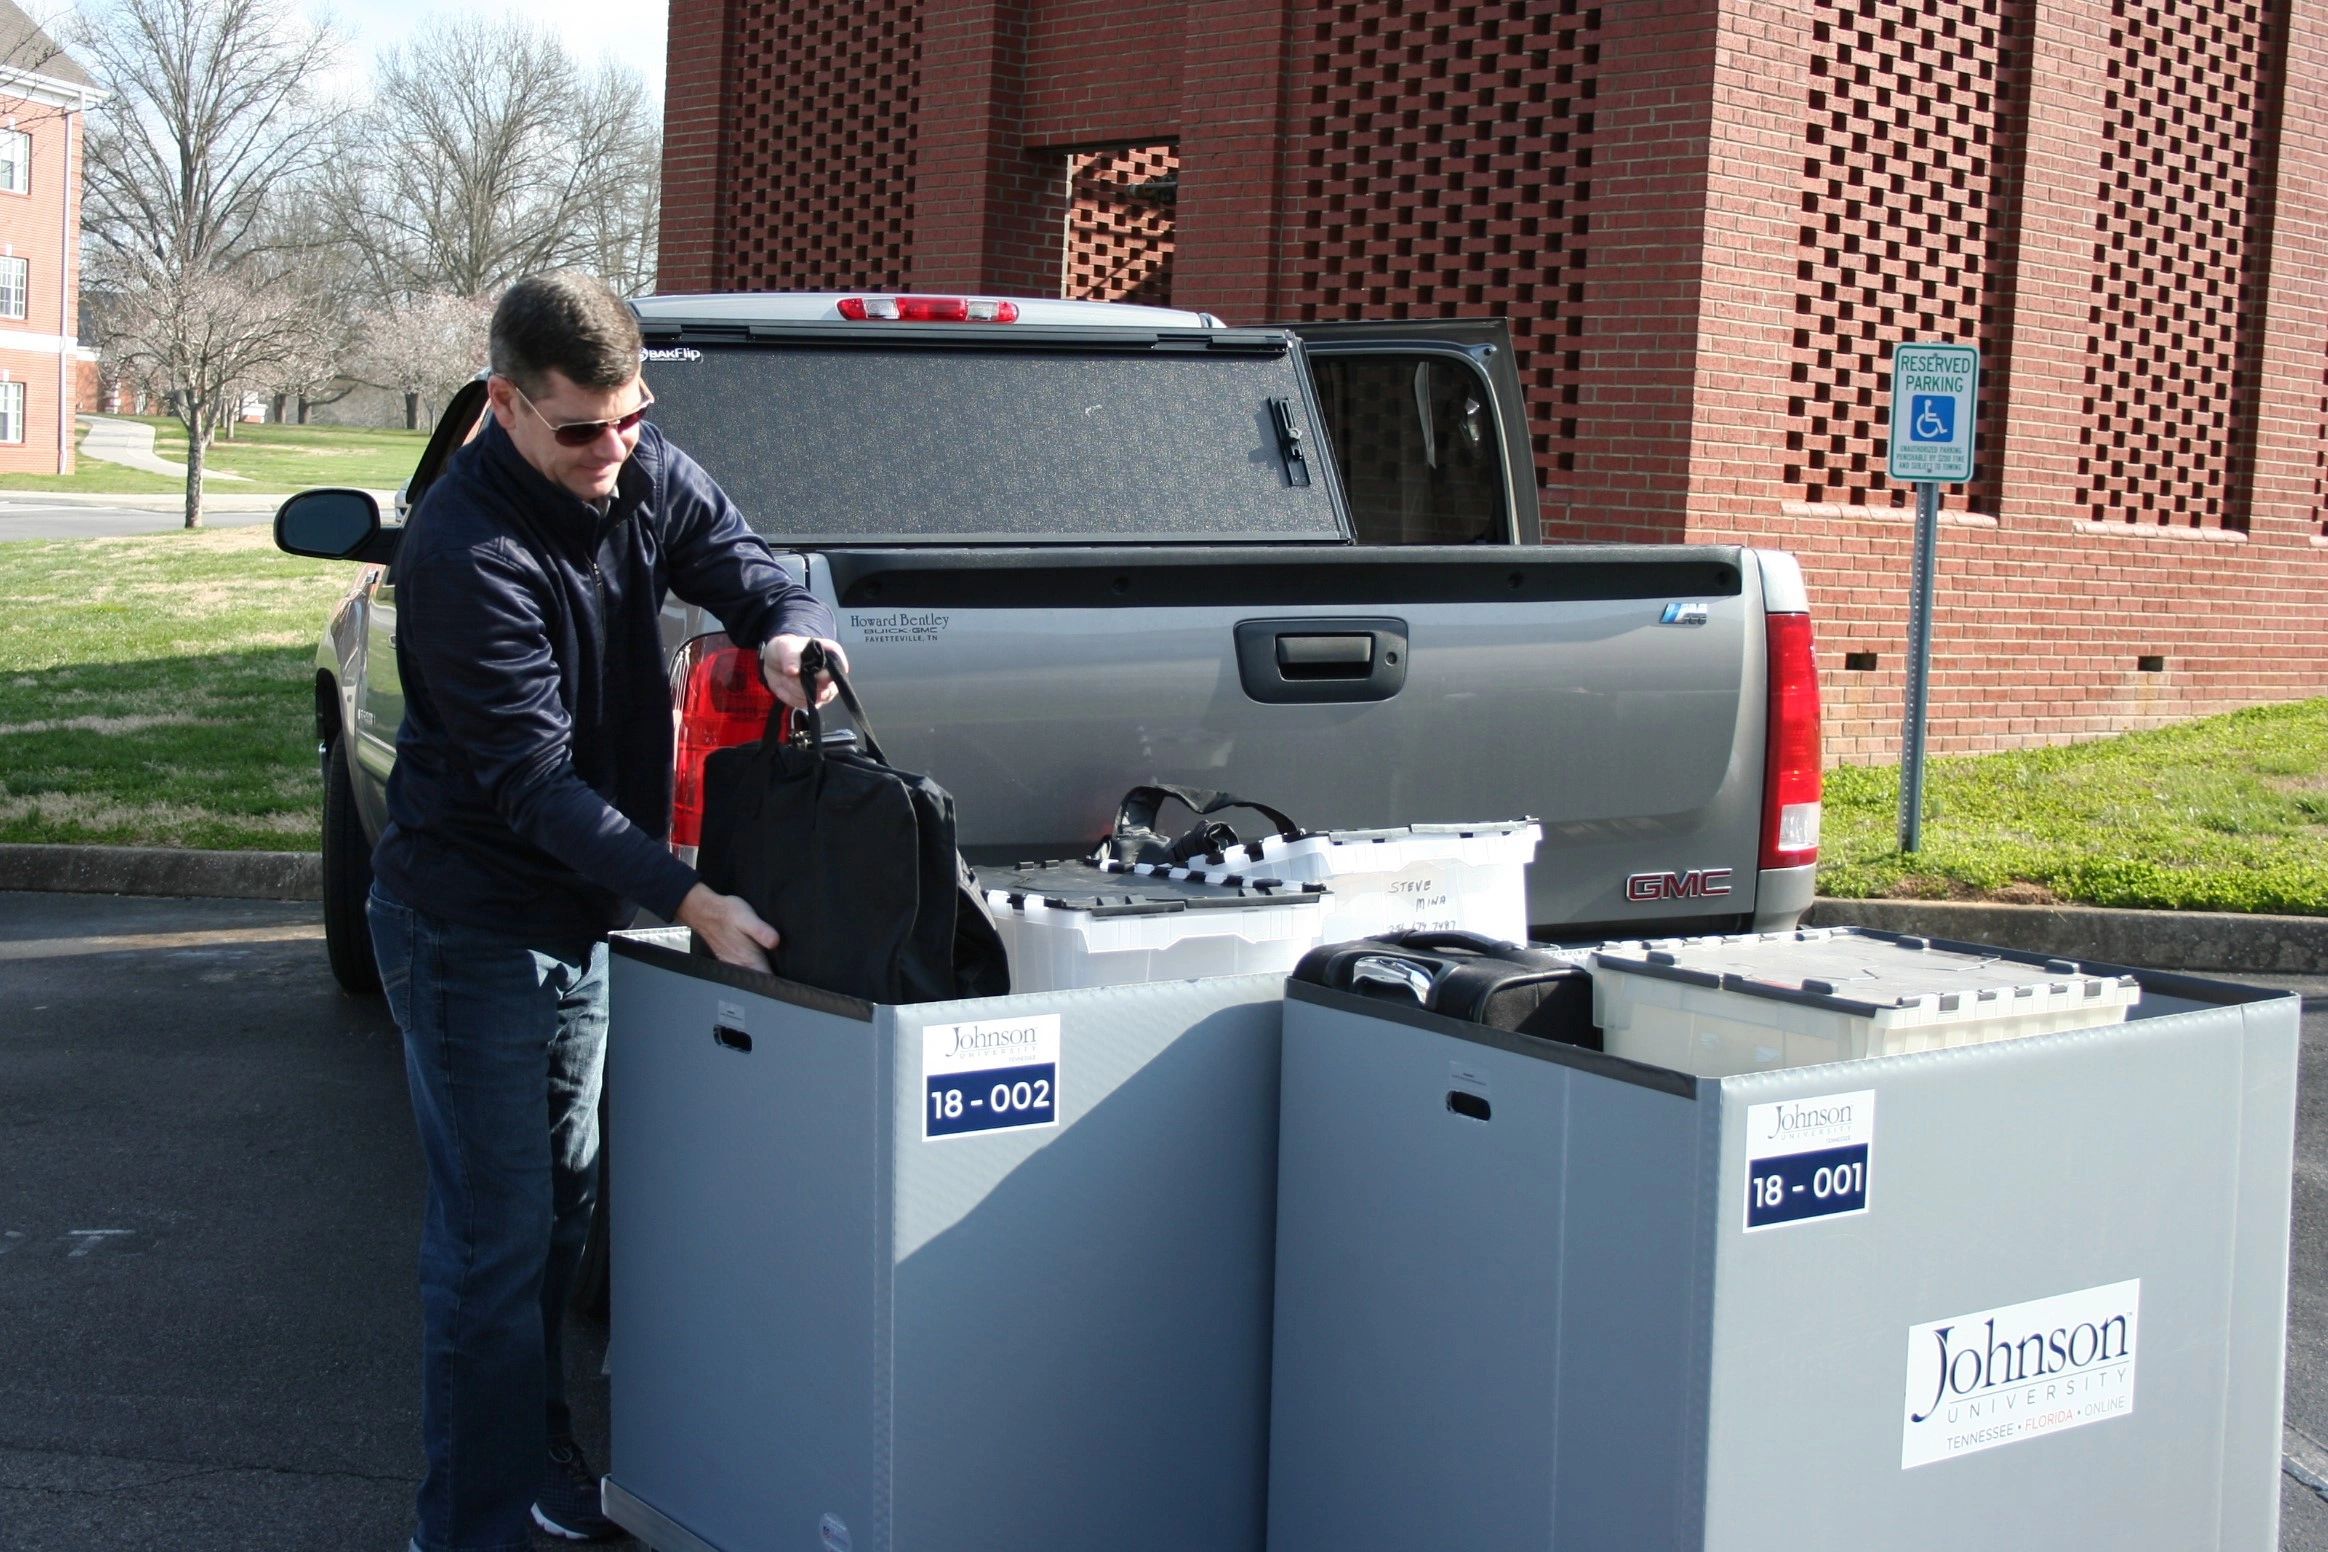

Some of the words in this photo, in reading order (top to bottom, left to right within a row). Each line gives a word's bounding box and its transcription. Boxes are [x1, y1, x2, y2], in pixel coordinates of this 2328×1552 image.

[1900, 355, 1971, 374] RESERVED
[1905, 375, 1964, 393] PARKING
[850, 613, 897, 628] Howard
[900, 612, 949, 630] Bentley
[1388, 880, 1432, 894] STEVE
[1626, 867, 1733, 901] GMC
[945, 1025, 1037, 1058] Johnson
[931, 1089, 963, 1120] 18
[990, 1079, 1050, 1113] 002
[1768, 1103, 1853, 1140] Johnson
[1753, 1174, 1784, 1208] 18
[1813, 1161, 1862, 1199] 001
[1910, 1316, 2129, 1423] Johnson
[1947, 1367, 2127, 1424] UNIVERSITY
[1947, 1422, 2015, 1451] TENNESSEE
[2024, 1408, 2074, 1432] FLORIDA
[2084, 1395, 2126, 1417] ONLINE
